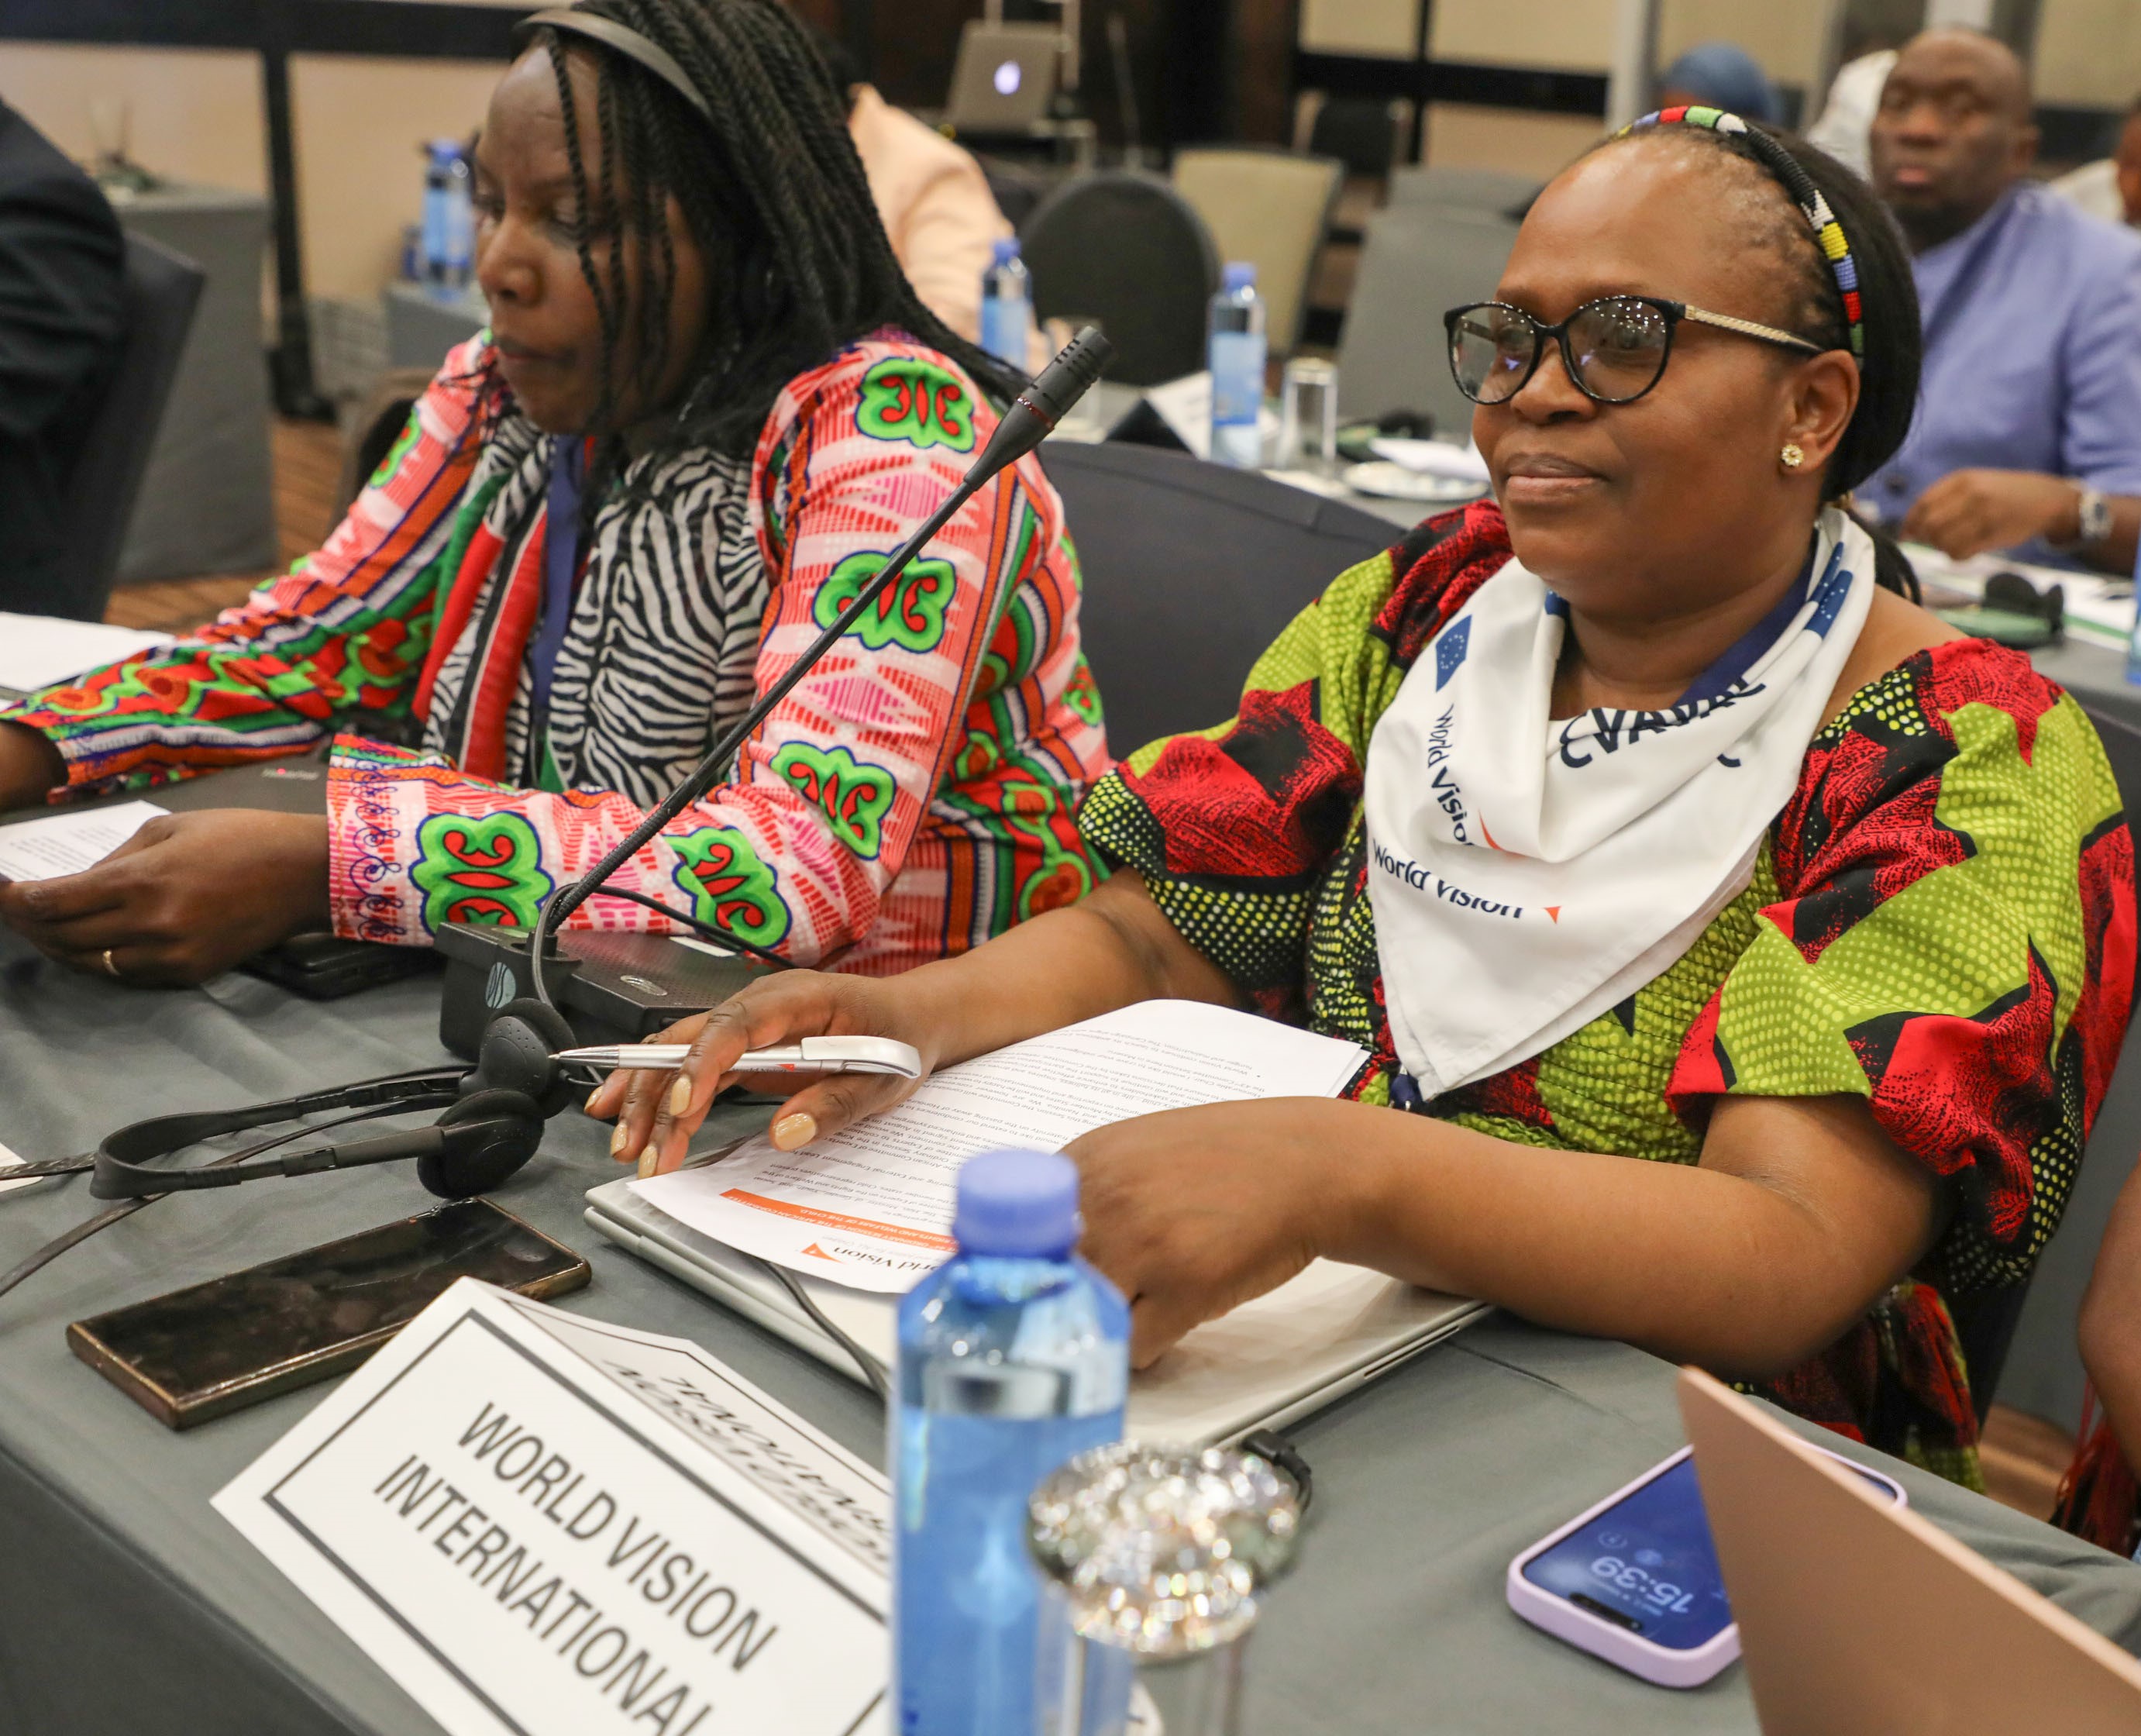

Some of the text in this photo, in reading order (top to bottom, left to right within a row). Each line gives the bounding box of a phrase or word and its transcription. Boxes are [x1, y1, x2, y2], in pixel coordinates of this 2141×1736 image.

[1428, 704, 1475, 846] World Visio
[1373, 838, 1431, 890] World
[982, 1080, 1006, 1089] happy
[974, 1085, 1009, 1097] however
[976, 1093, 1021, 1107] Committee
[915, 1107, 964, 1121] condolences
[972, 1113, 1003, 1124] passing
[863, 1123, 889, 1133] would
[882, 1120, 912, 1131] August
[927, 1124, 966, 1136] enhanced
[979, 1122, 1008, 1133] extend
[921, 1129, 949, 1140] signed
[1034, 1135, 1060, 1145] would
[827, 1136, 859, 1148] Experts
[880, 1142, 911, 1153] Session
[891, 1137, 923, 1149] Experts
[867, 1146, 912, 1161] Committee
[912, 1149, 950, 1162] Ordinary
[769, 1162, 799, 1172] present
[821, 1154, 871, 1170] Engagement
[911, 1157, 942, 1168] African
[783, 1174, 814, 1184] Welfare
[798, 1167, 856, 1185] representatives
[871, 1167, 906, 1179] External
[829, 1183, 854, 1193] Rights
[776, 1211, 817, 1223] AFRICAN
[845, 1225, 883, 1237] SESSION
[857, 1221, 898, 1233] WELFARE
[883, 1234, 929, 1247] ORDINARY
[917, 1233, 951, 1243] RIGHTS
[831, 1246, 894, 1268] Vision
[458, 1402, 618, 1541] WORLD
[606, 1516, 779, 1671] VISION
[1590, 1555, 1694, 1614] 15:39
